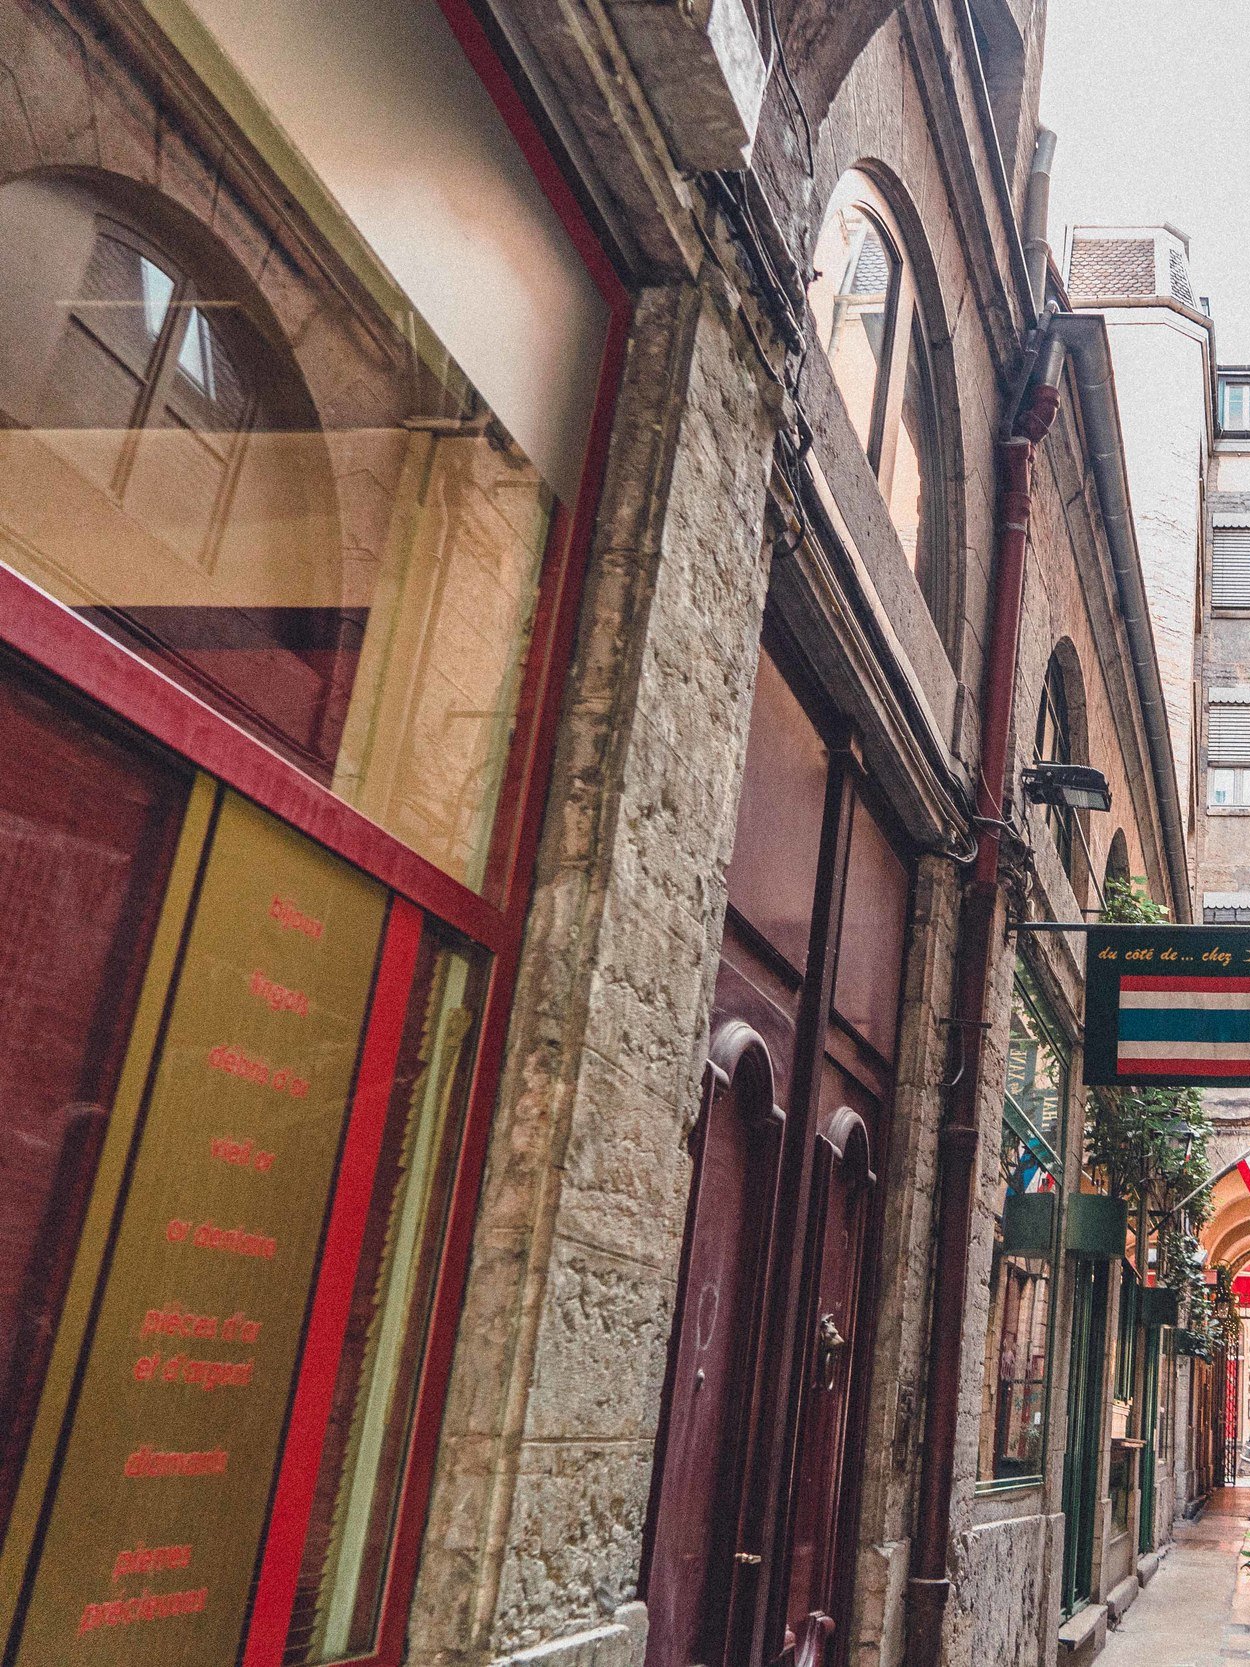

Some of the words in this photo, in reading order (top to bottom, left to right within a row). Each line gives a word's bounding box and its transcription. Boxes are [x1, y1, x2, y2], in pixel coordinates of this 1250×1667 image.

[1098, 946, 1118, 960] du
[1124, 947, 1154, 961] côté
[1202, 947, 1232, 967] chez
